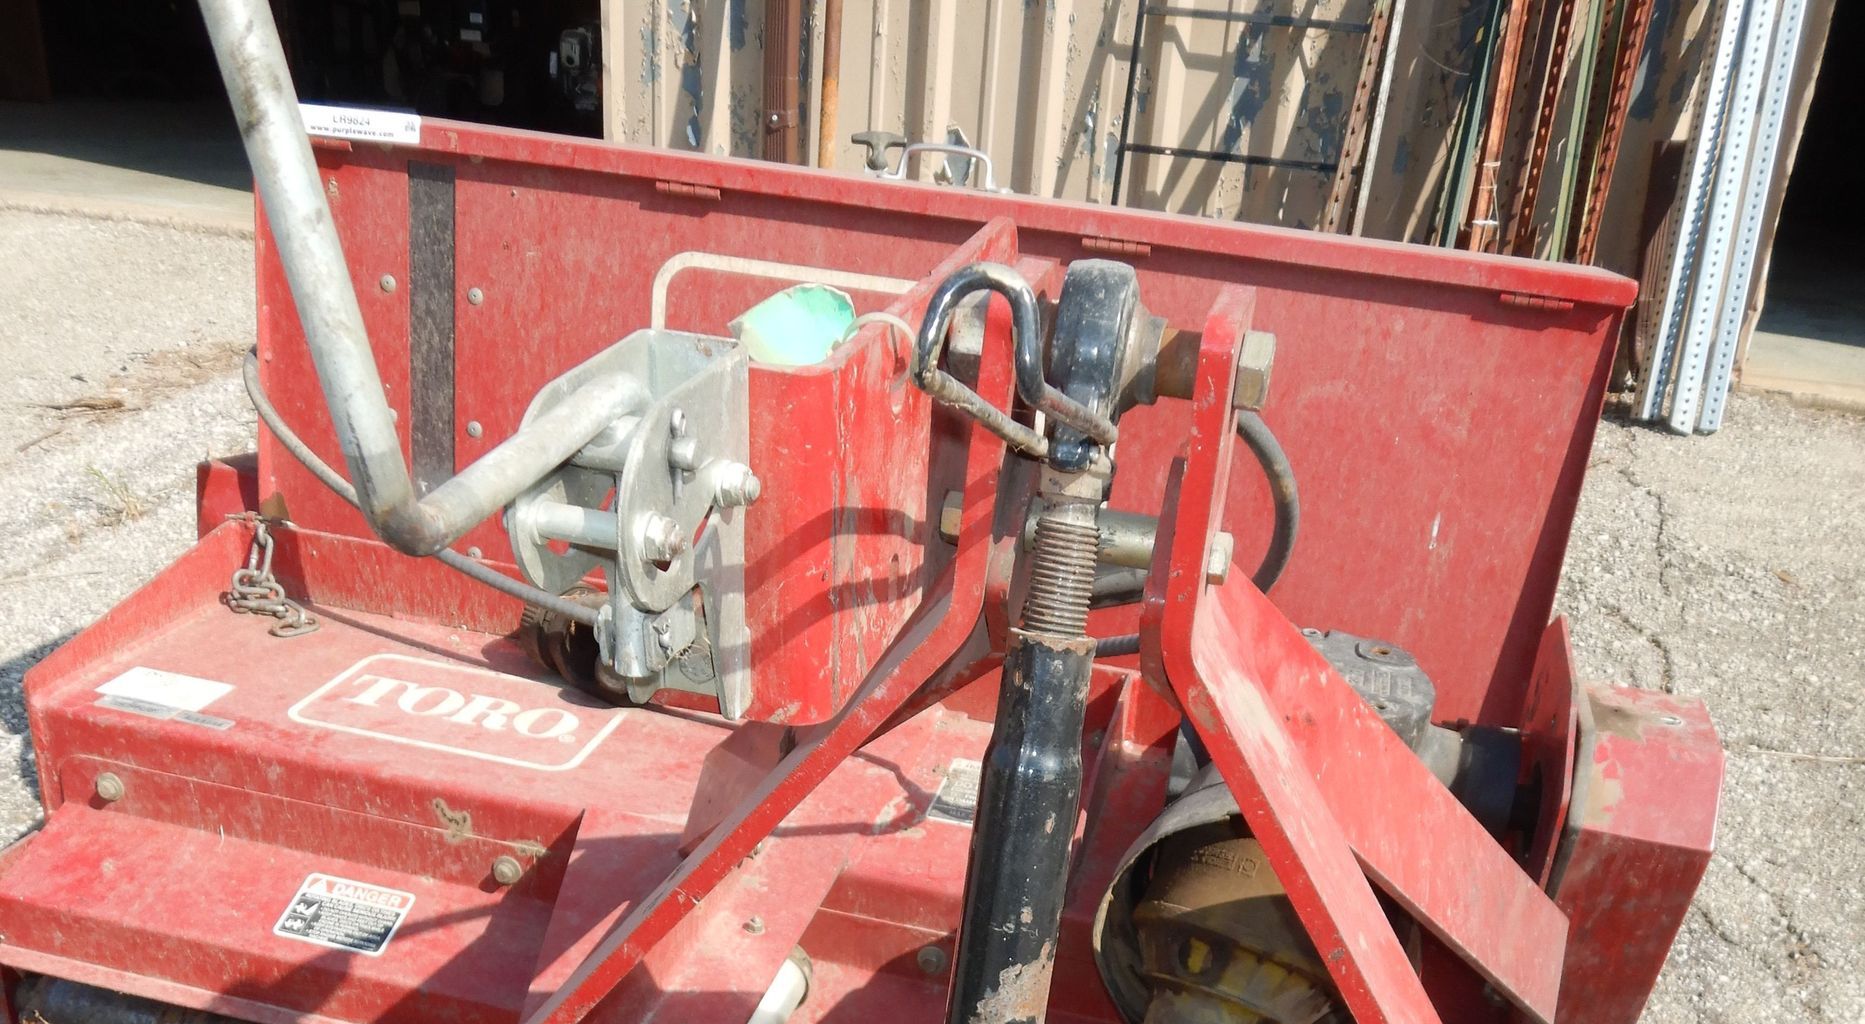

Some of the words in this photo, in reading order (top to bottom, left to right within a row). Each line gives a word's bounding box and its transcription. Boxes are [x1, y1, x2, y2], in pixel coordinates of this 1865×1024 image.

[310, 124, 395, 138] www.purplewave.com
[343, 673, 580, 740] TORO
[331, 882, 403, 907] DANGER
